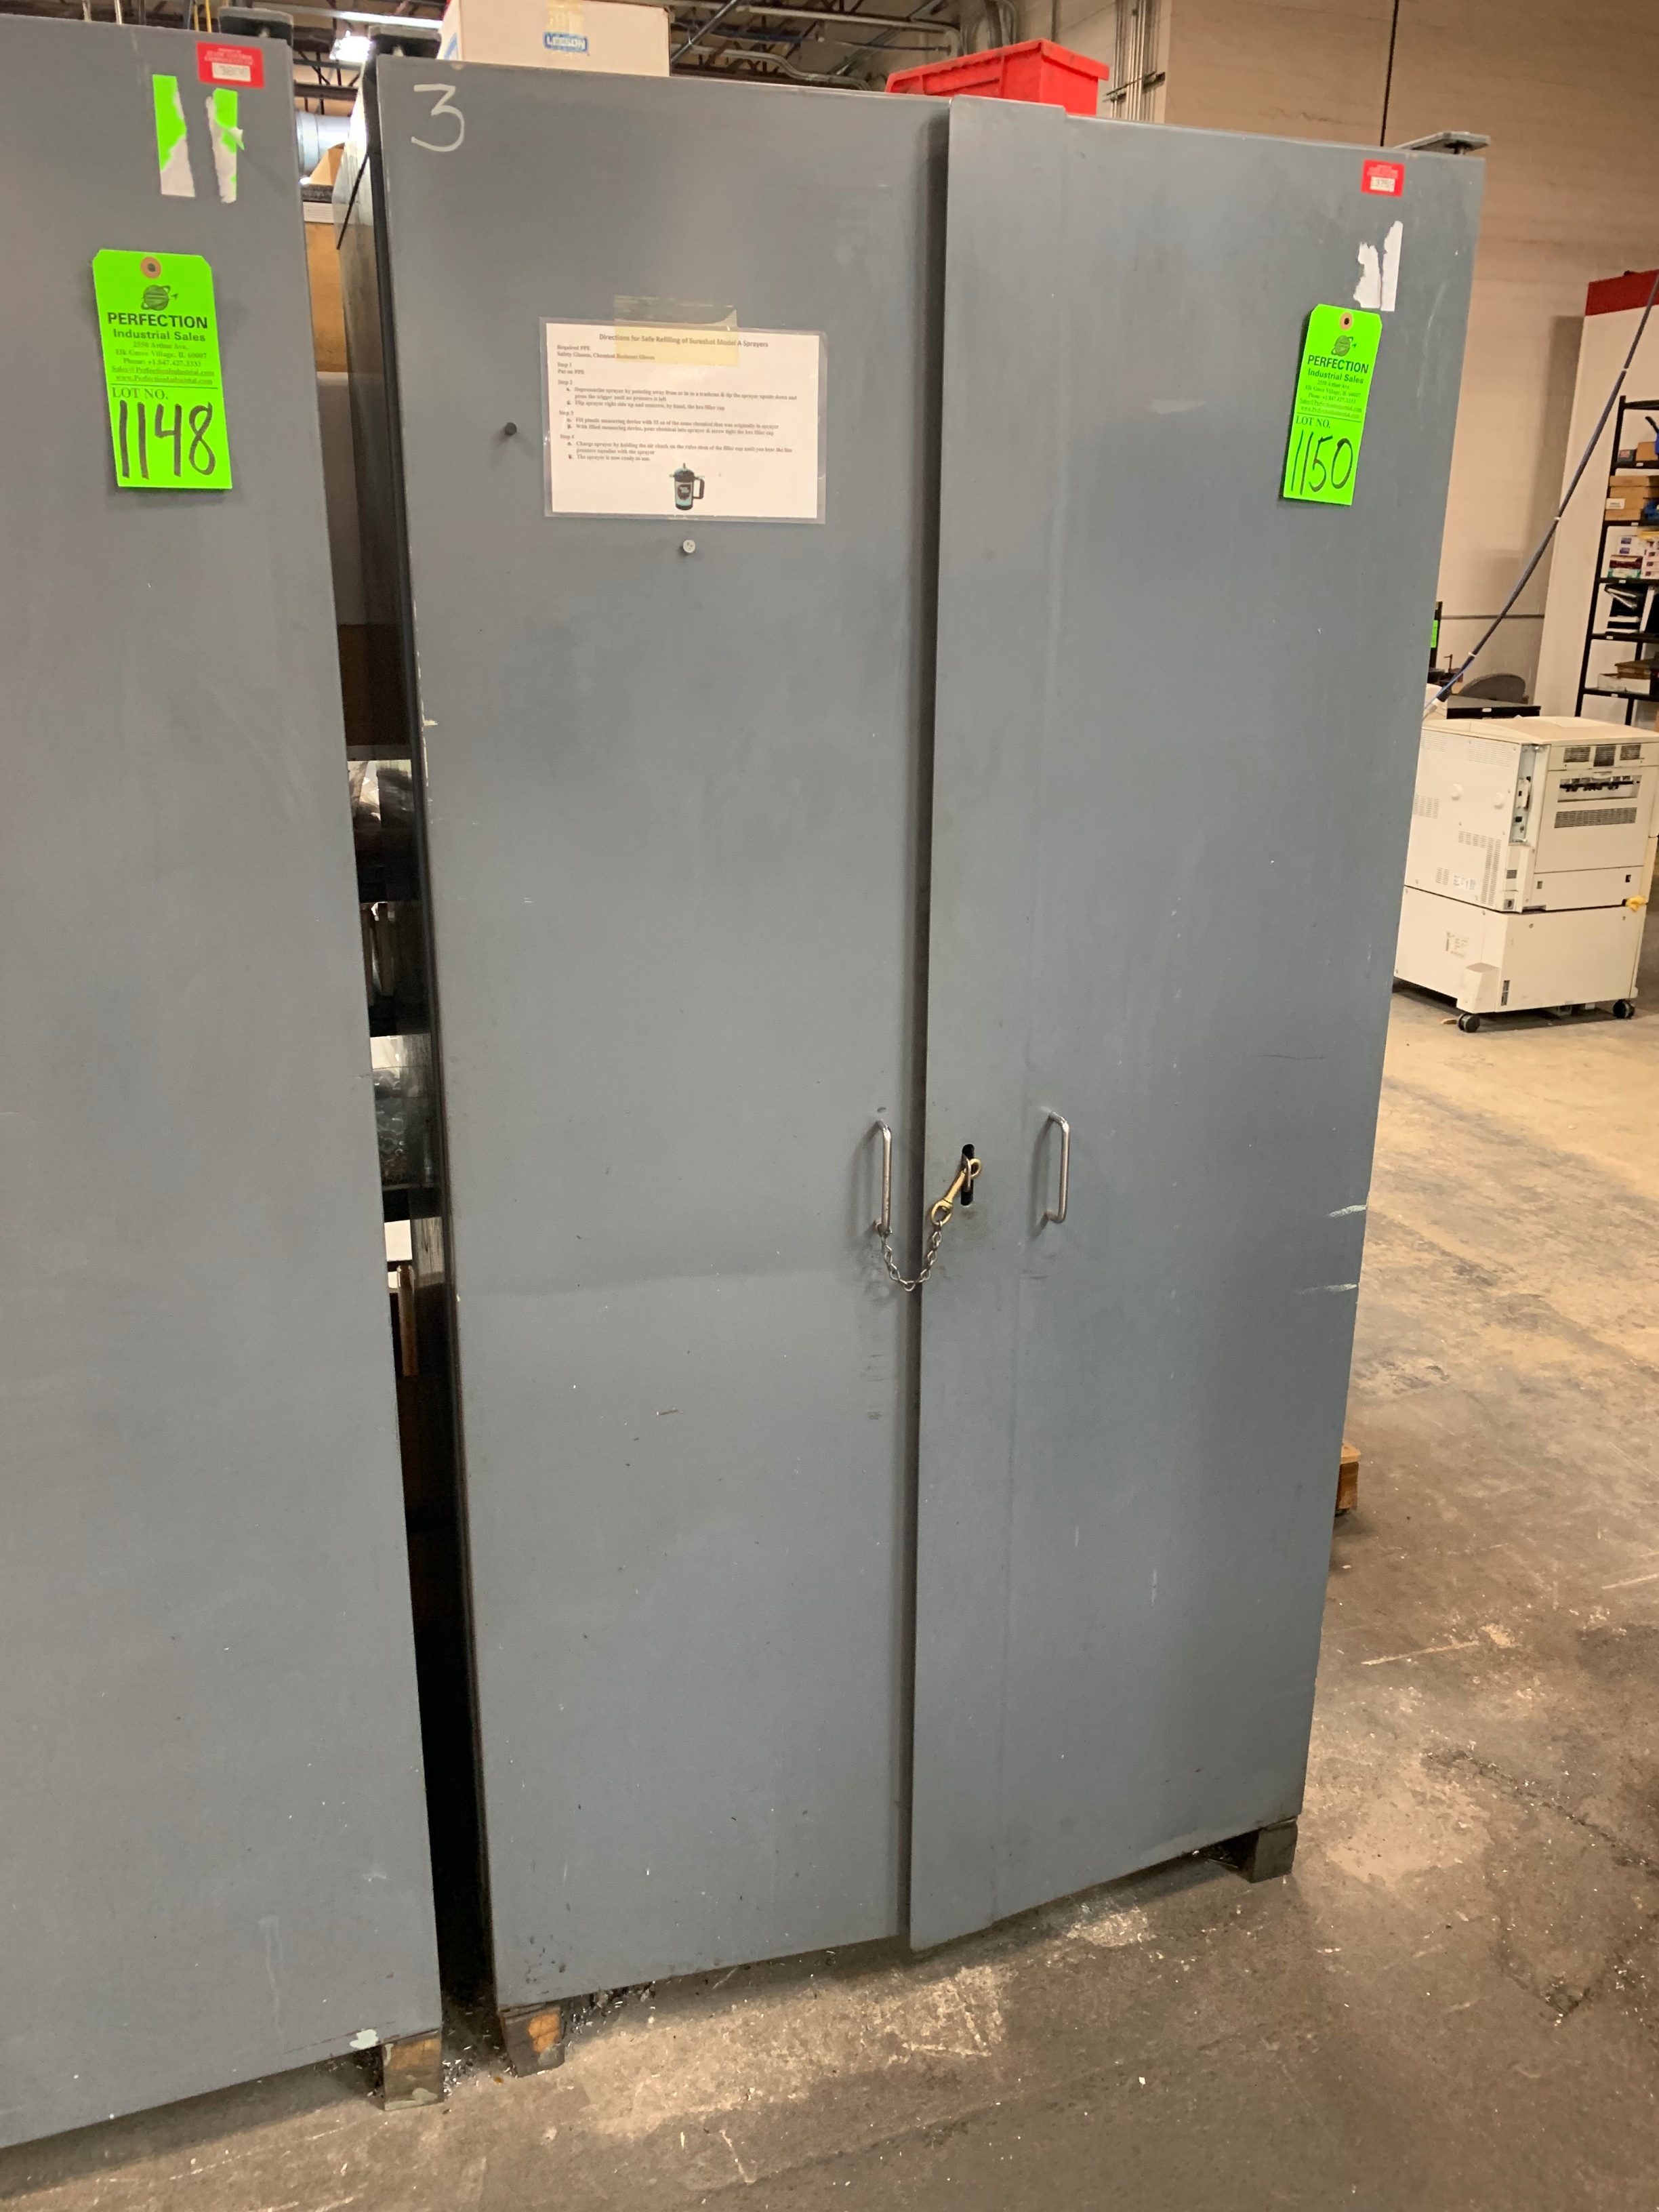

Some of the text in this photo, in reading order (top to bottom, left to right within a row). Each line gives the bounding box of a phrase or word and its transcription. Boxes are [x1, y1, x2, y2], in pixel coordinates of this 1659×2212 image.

[546, 36, 586, 49] LEESON
[411, 83, 465, 153] 3
[108, 312, 207, 329] PERFECTION
[113, 329, 205, 342] Industrial Sales
[656, 336, 680, 344] Refilling
[743, 340, 769, 348] Sprayers
[1307, 354, 1369, 373] PERFECTION
[1307, 368, 1364, 384] Industrial Sales
[112, 387, 169, 400] LOT NO.
[1296, 415, 1330, 428] LOT NO.
[119, 400, 216, 480] 1148
[1291, 429, 1353, 495] 1150
